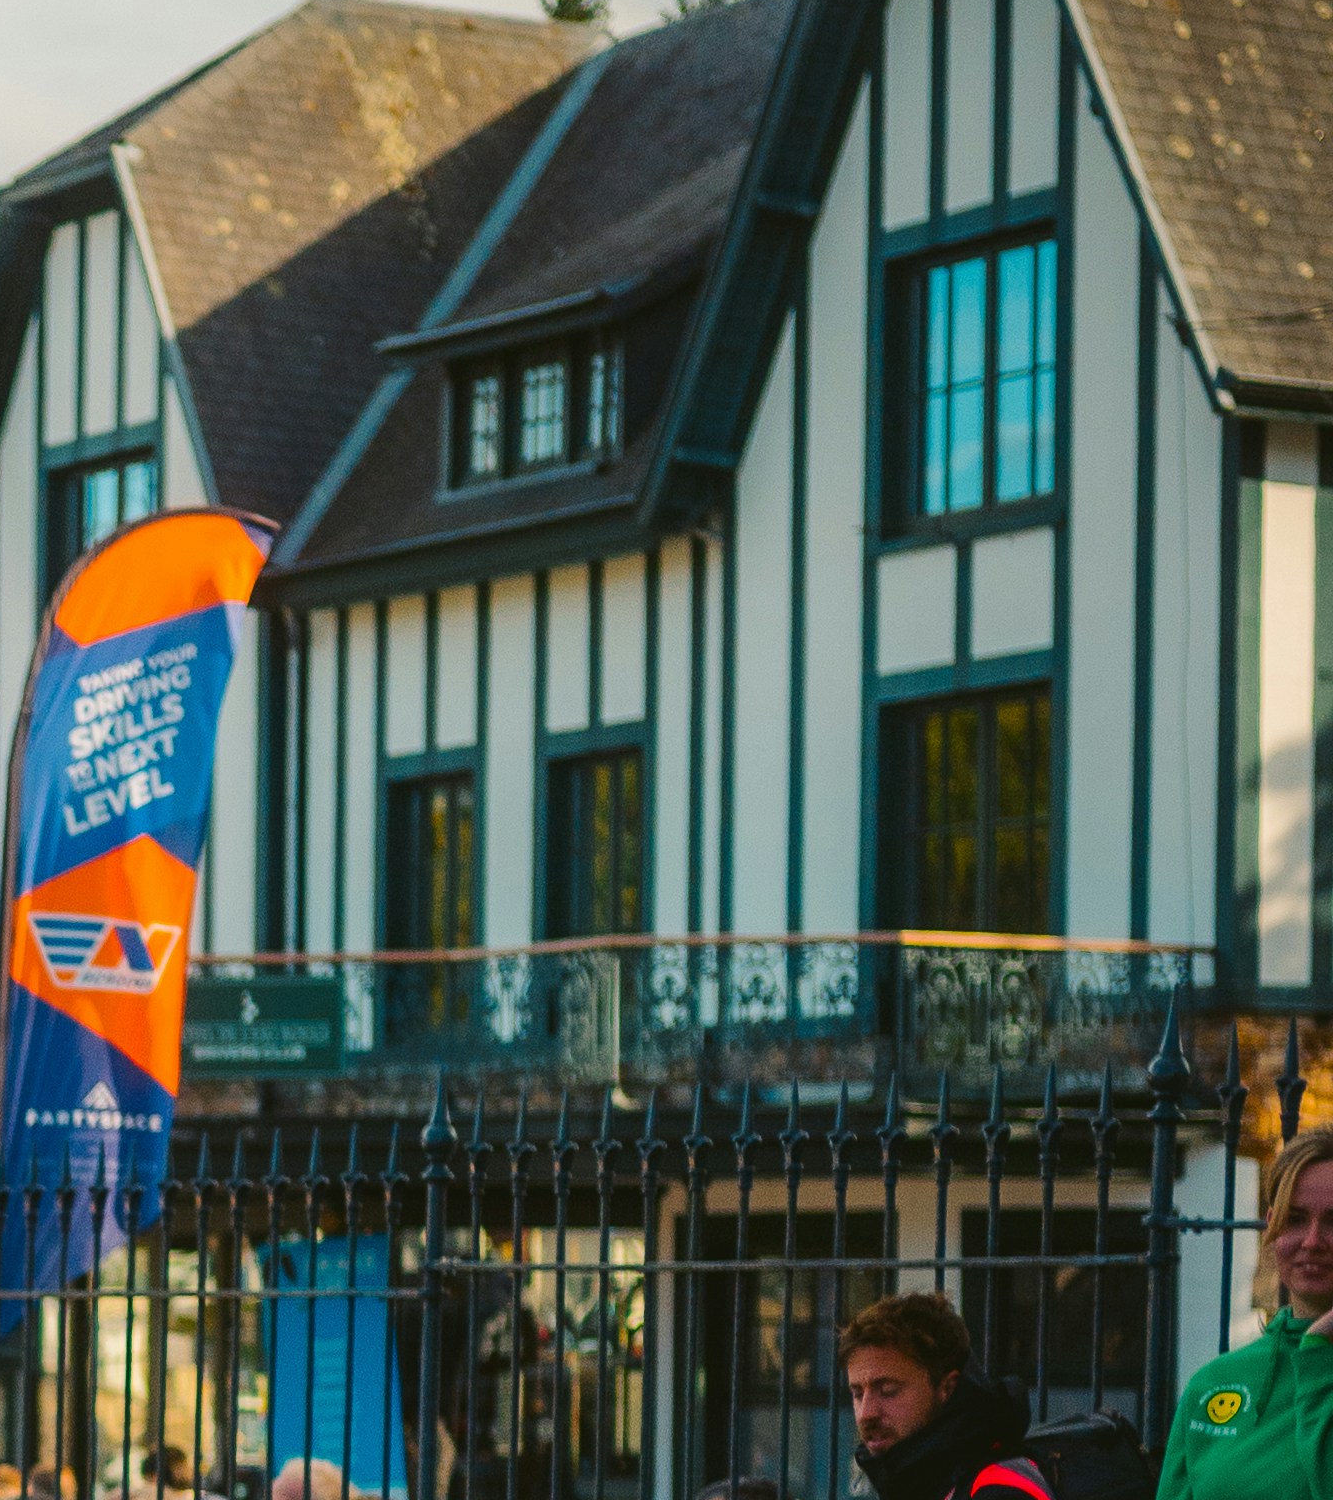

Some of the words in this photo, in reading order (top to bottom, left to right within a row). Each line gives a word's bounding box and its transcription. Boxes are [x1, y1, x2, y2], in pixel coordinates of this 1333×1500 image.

[74, 665, 192, 724] DRIVING
[68, 693, 184, 760] SKILLS
[94, 726, 179, 783] NEXT
[64, 767, 175, 837] LEVEL
